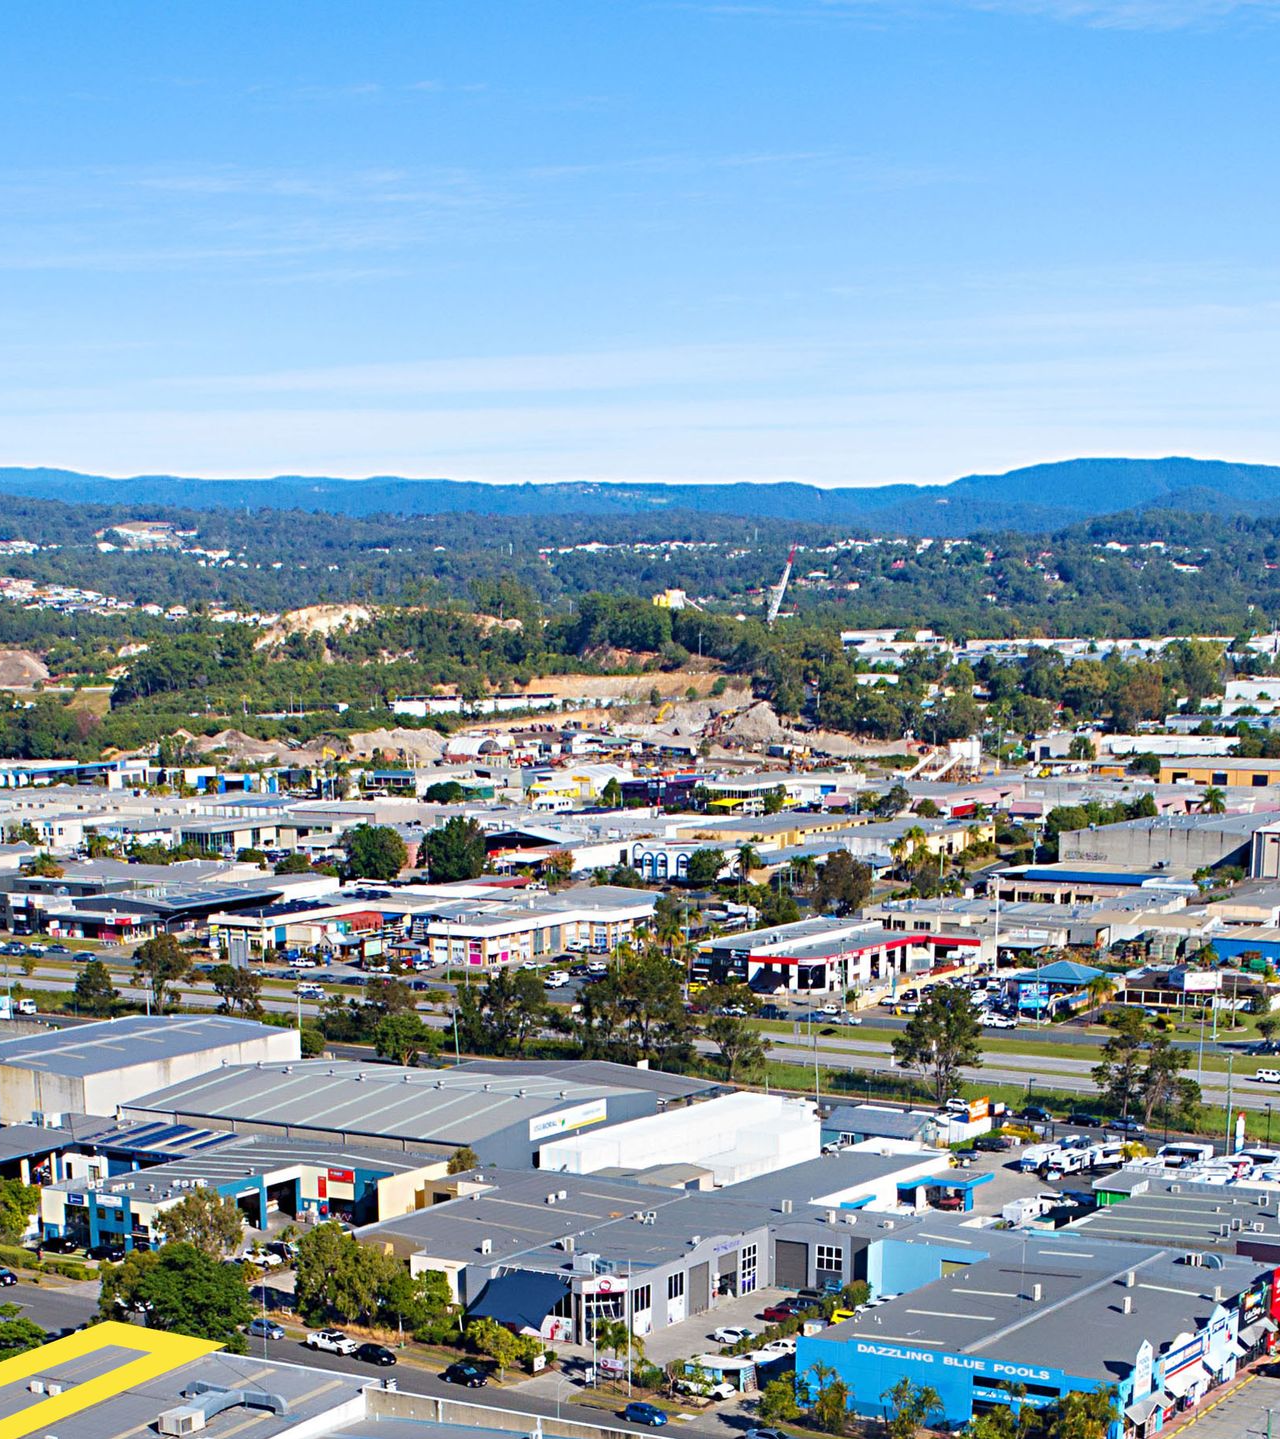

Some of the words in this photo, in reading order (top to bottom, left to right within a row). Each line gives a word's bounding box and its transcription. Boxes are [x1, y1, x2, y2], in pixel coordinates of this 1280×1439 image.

[856, 1343, 934, 1364] DAZZLING
[943, 1355, 985, 1371] BLUE
[993, 1363, 1051, 1381] POOLS
